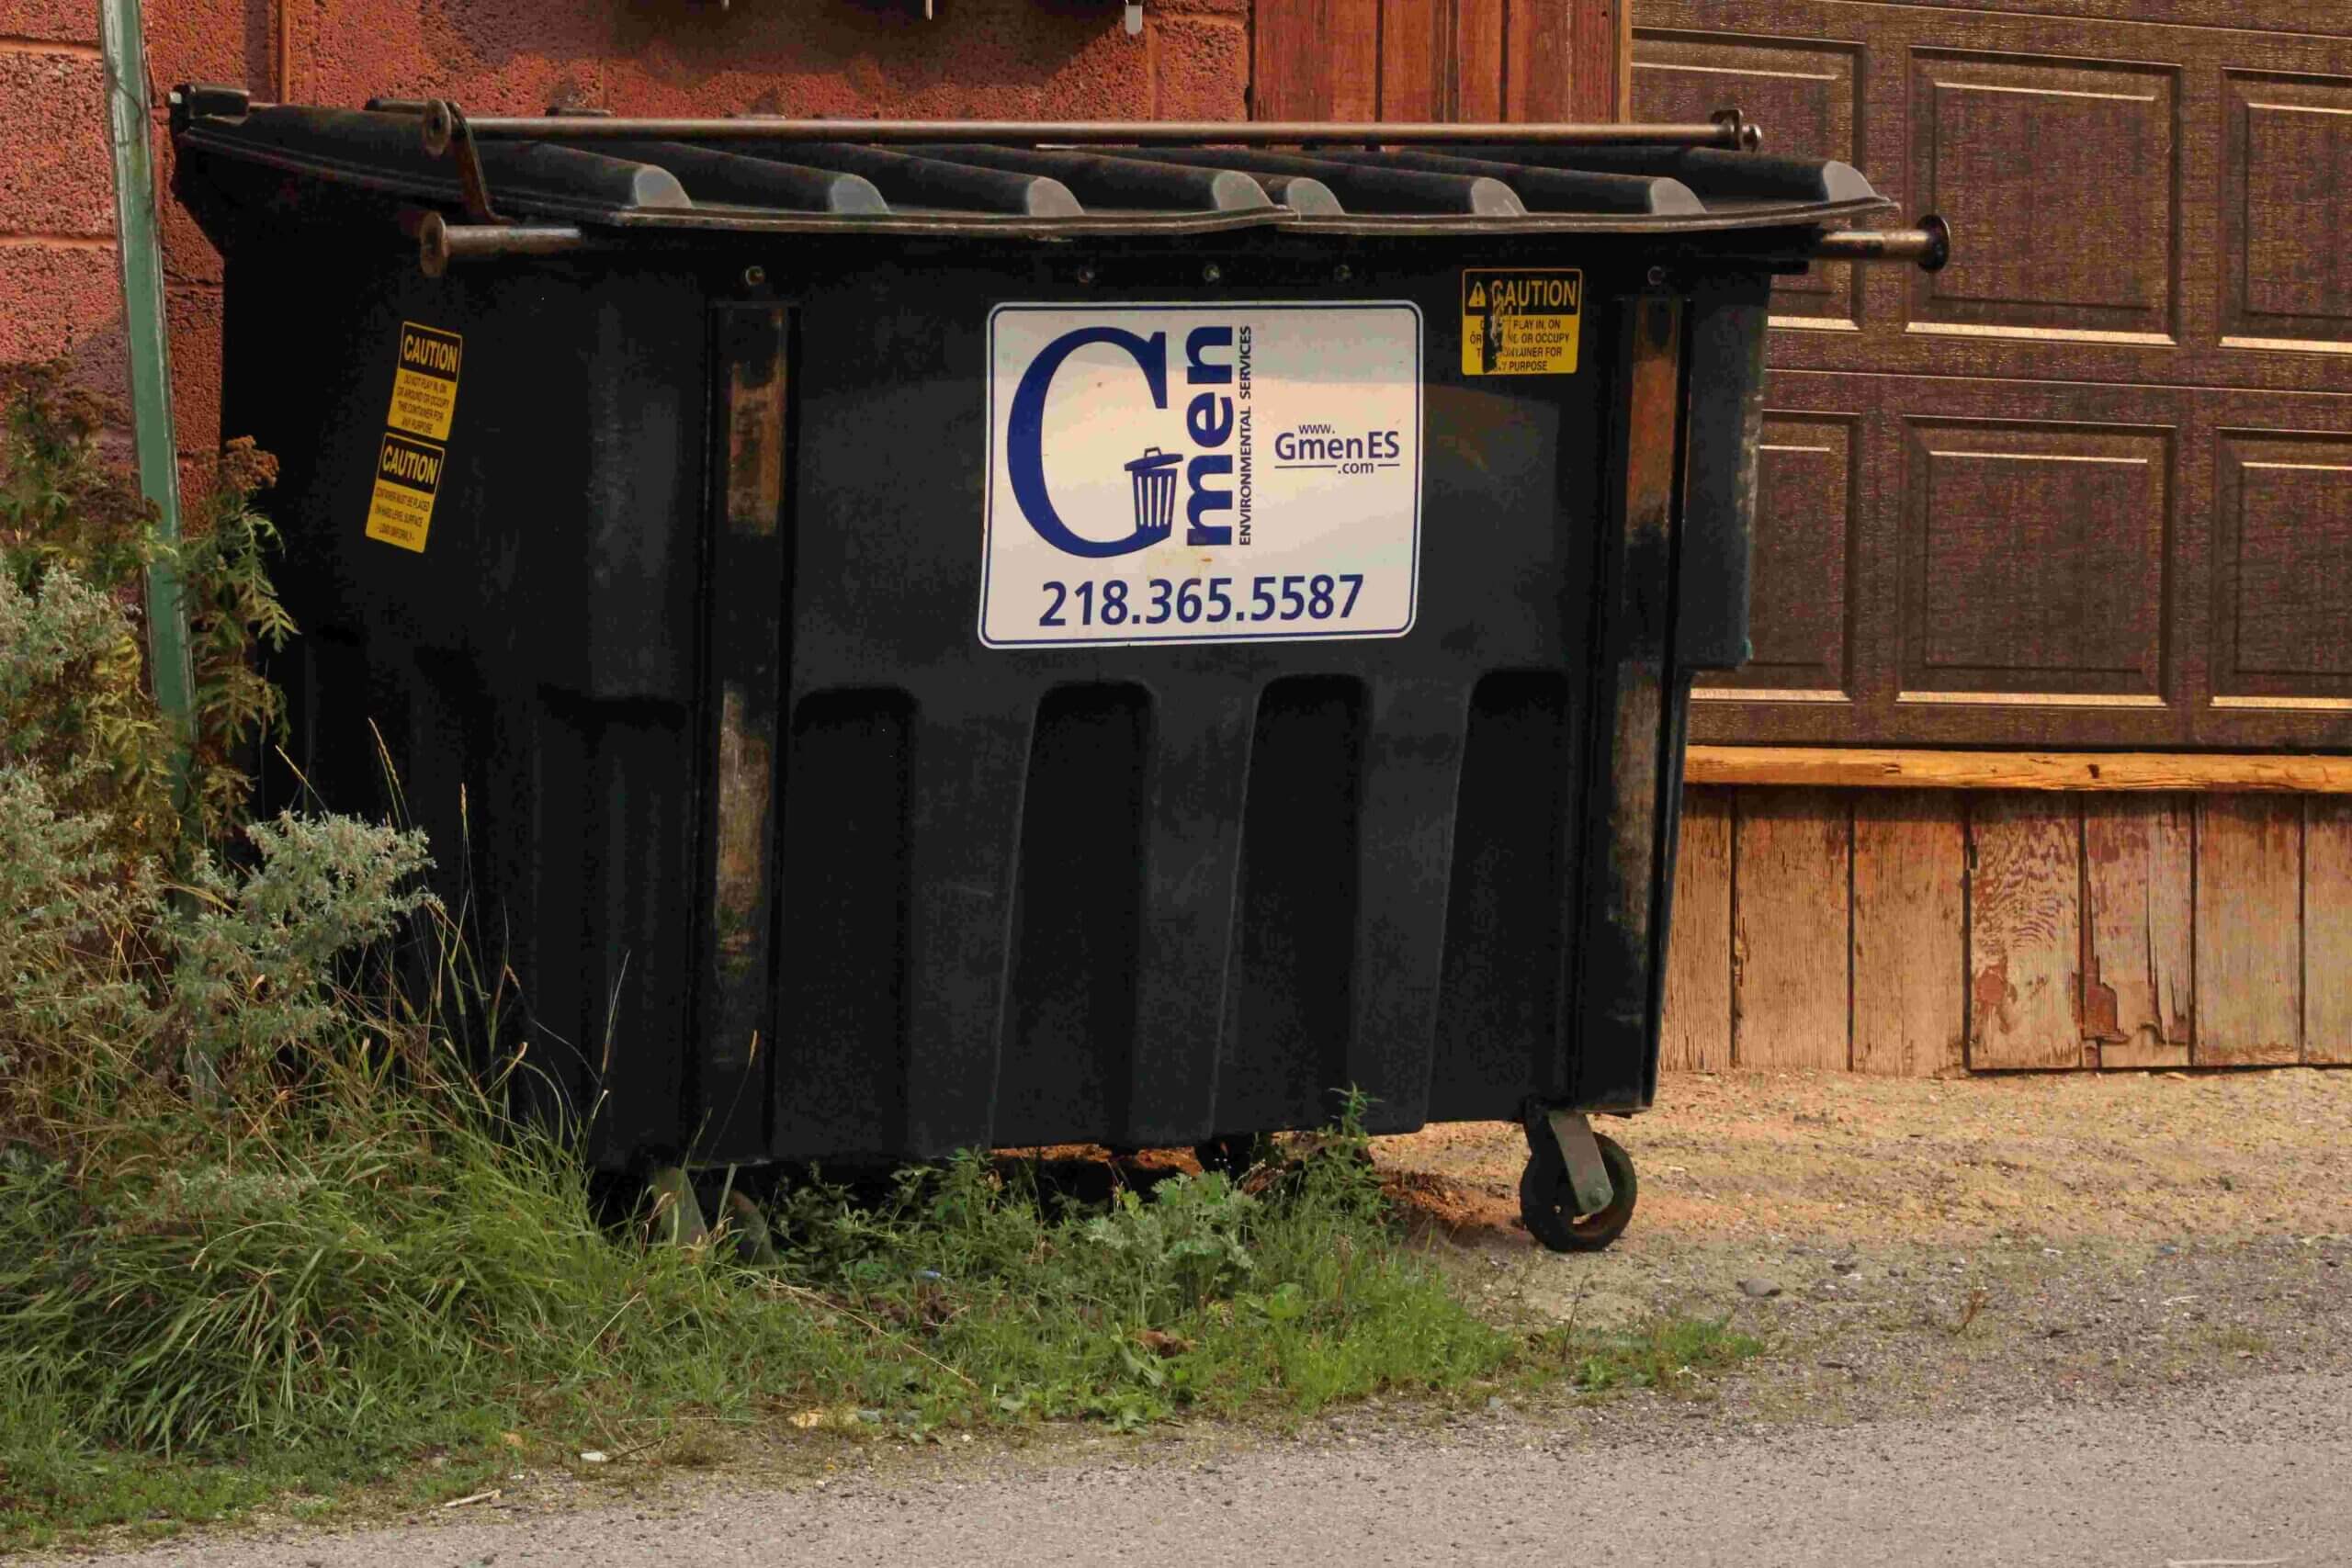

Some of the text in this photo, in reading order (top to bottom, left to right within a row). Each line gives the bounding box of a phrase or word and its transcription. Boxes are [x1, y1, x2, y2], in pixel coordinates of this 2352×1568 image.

[1492, 280, 1577, 307] CAUTION
[1548, 320, 1560, 329] ON
[1521, 333, 1533, 343] OR
[1536, 333, 1569, 343] OCCUPY
[403, 333, 458, 373] CAUTION
[1546, 348, 1562, 356] FOR
[1510, 361, 1547, 371] PURPOSE
[1298, 423, 1336, 434] www.
[1239, 325, 1251, 546] ENVIRONMENTAL SERVICES
[382, 445, 439, 485] CAUTION
[1338, 462, 1374, 474] .com
[1039, 573, 1364, 626] 218.365.5587
